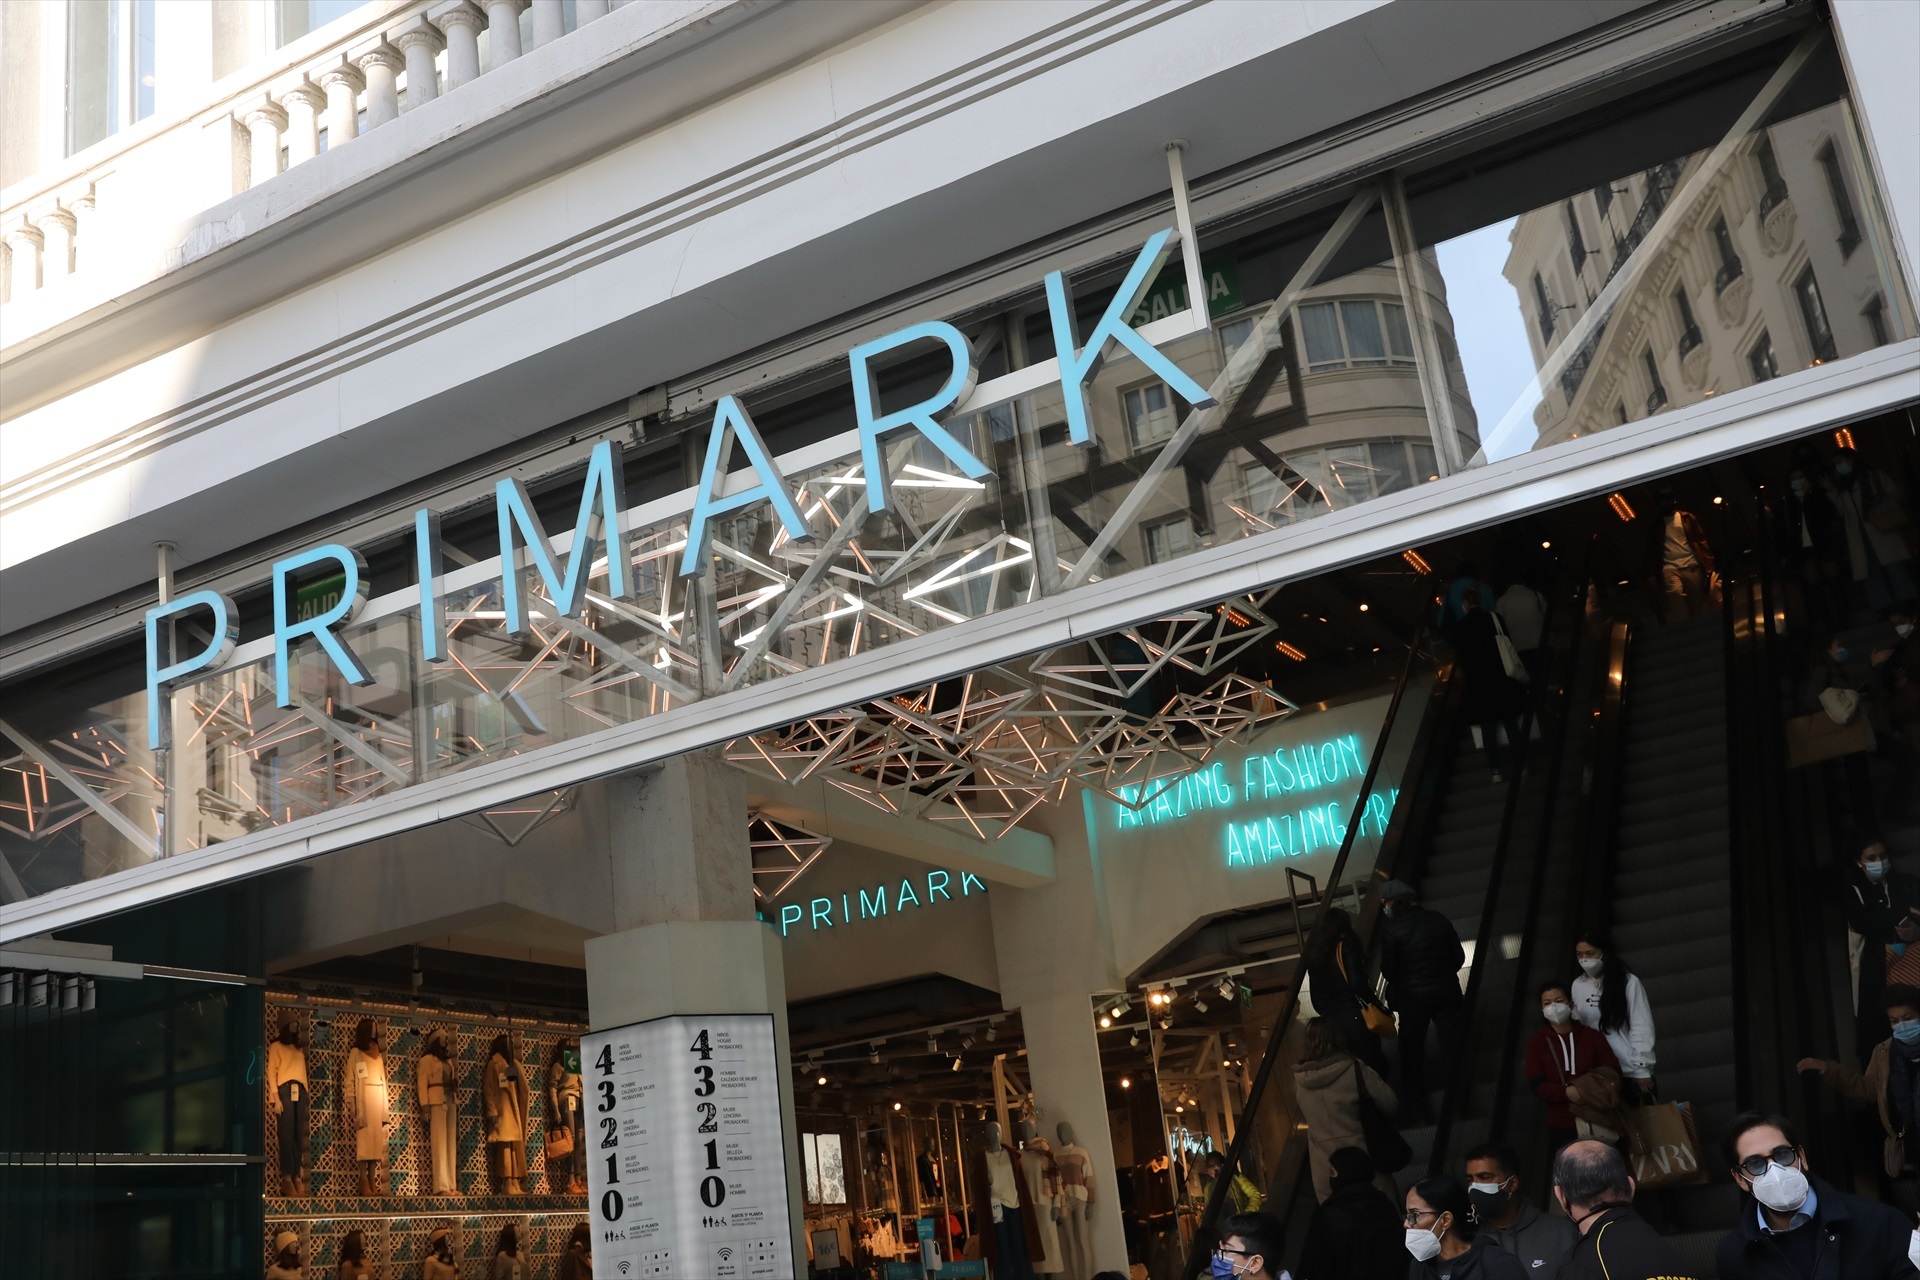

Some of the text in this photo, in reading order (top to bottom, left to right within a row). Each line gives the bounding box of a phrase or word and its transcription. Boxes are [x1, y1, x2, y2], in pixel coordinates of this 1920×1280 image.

[1134, 271, 1230, 326] SALIA
[145, 226, 1216, 750] PRIMARK
[297, 589, 345, 623] ALID
[1118, 734, 1366, 828] AMAZING FASHION
[1228, 802, 1347, 866] AMAZING
[781, 870, 987, 937] PRIMARK
[594, 1044, 615, 1077] 4
[690, 1029, 713, 1060] 4
[597, 1080, 616, 1113] 3
[694, 1065, 715, 1097] 3
[600, 1117, 618, 1149] 2
[696, 1102, 718, 1134] 2
[605, 1152, 620, 1185] 1
[704, 1138, 721, 1170] 1
[1630, 1142, 1697, 1181] ZARA
[601, 1189, 624, 1222] 0
[700, 1175, 726, 1208] 0
